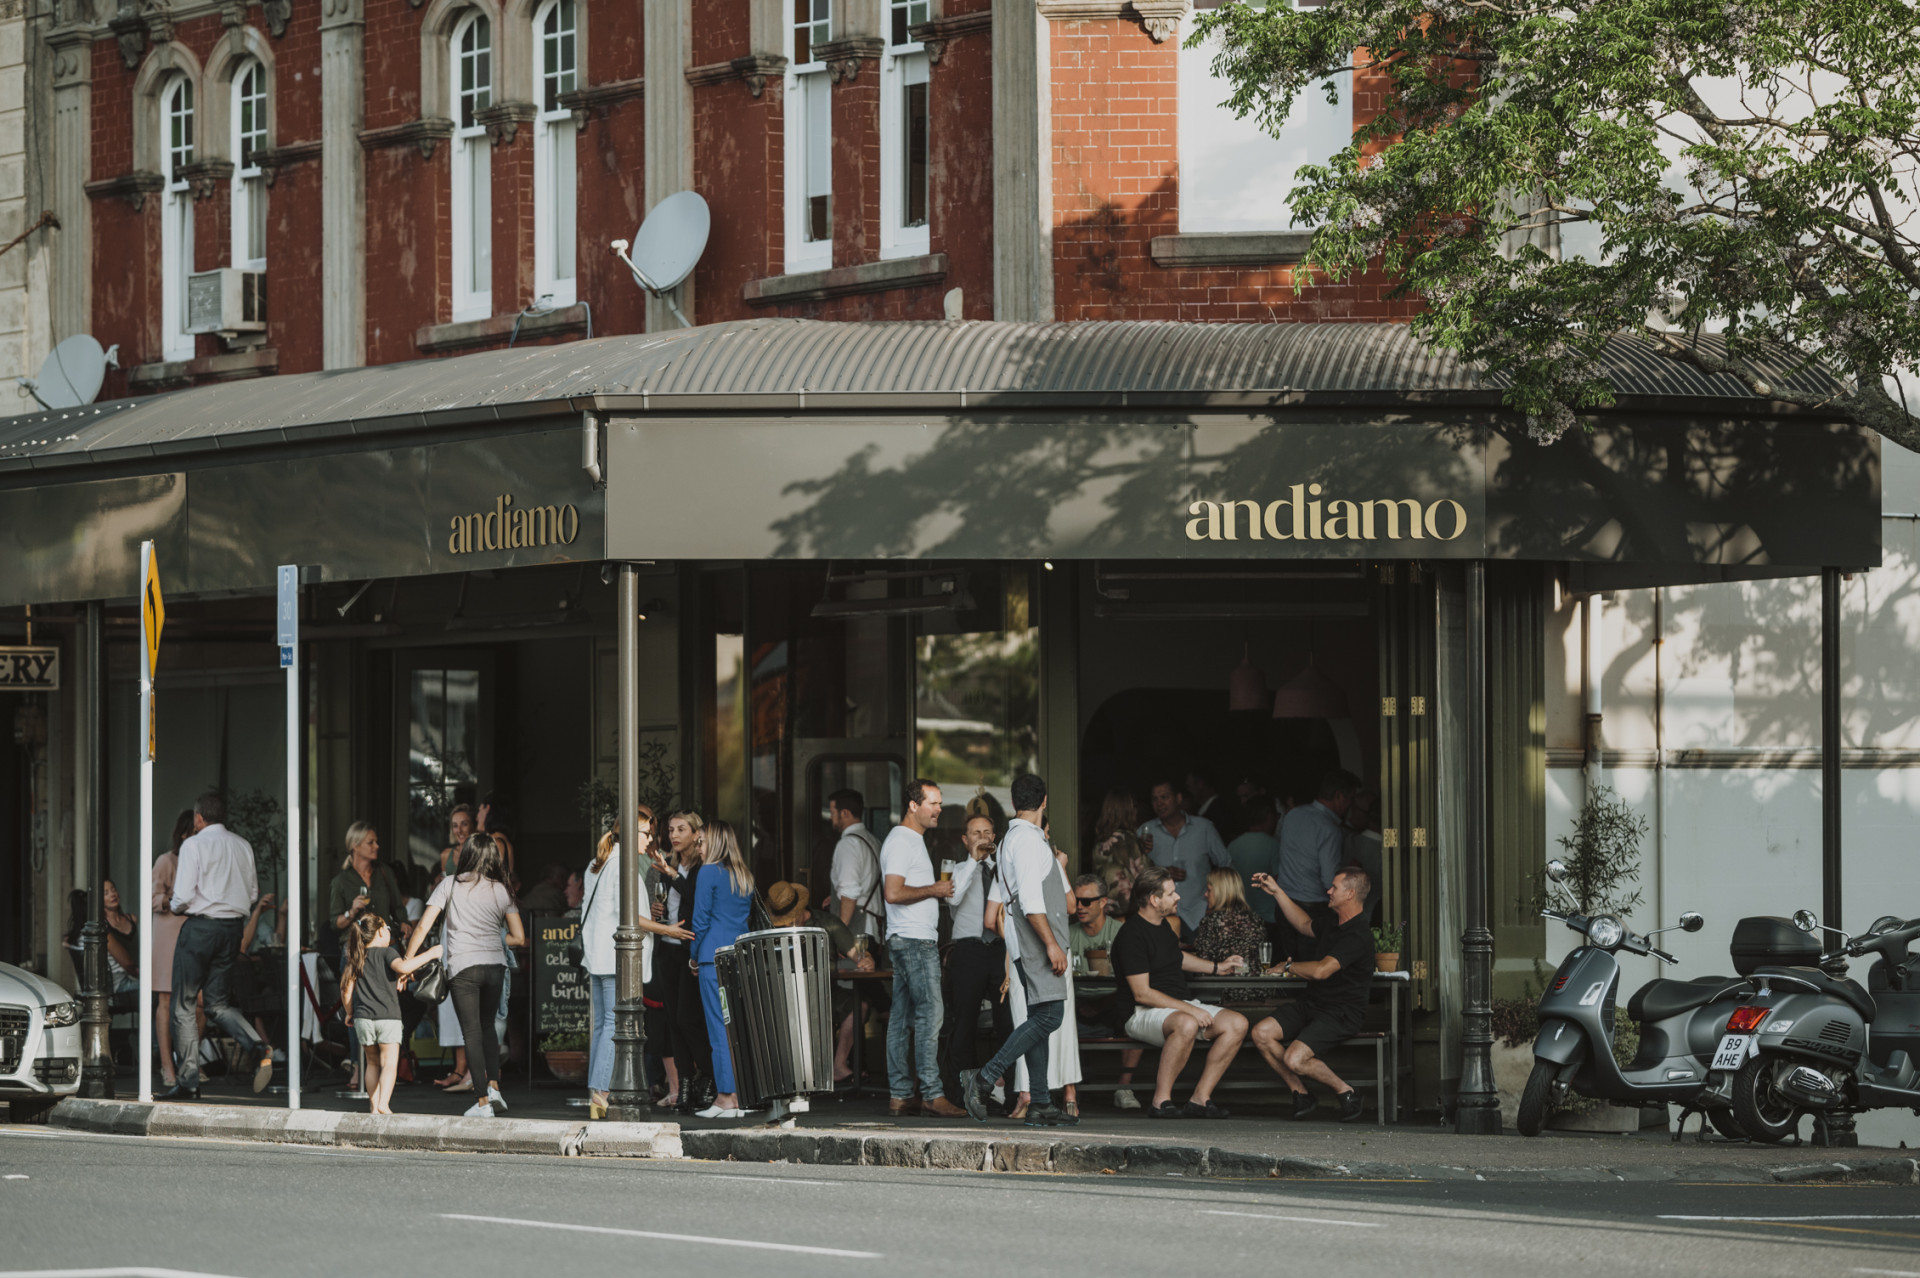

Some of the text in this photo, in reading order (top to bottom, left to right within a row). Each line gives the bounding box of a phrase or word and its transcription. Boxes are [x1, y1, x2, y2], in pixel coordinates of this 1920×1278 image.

[448, 494, 578, 554] andiamo
[1185, 482, 1467, 541] andiamo
[1715, 1053, 1739, 1066] AHE
[1725, 1038, 1742, 1050] B9
